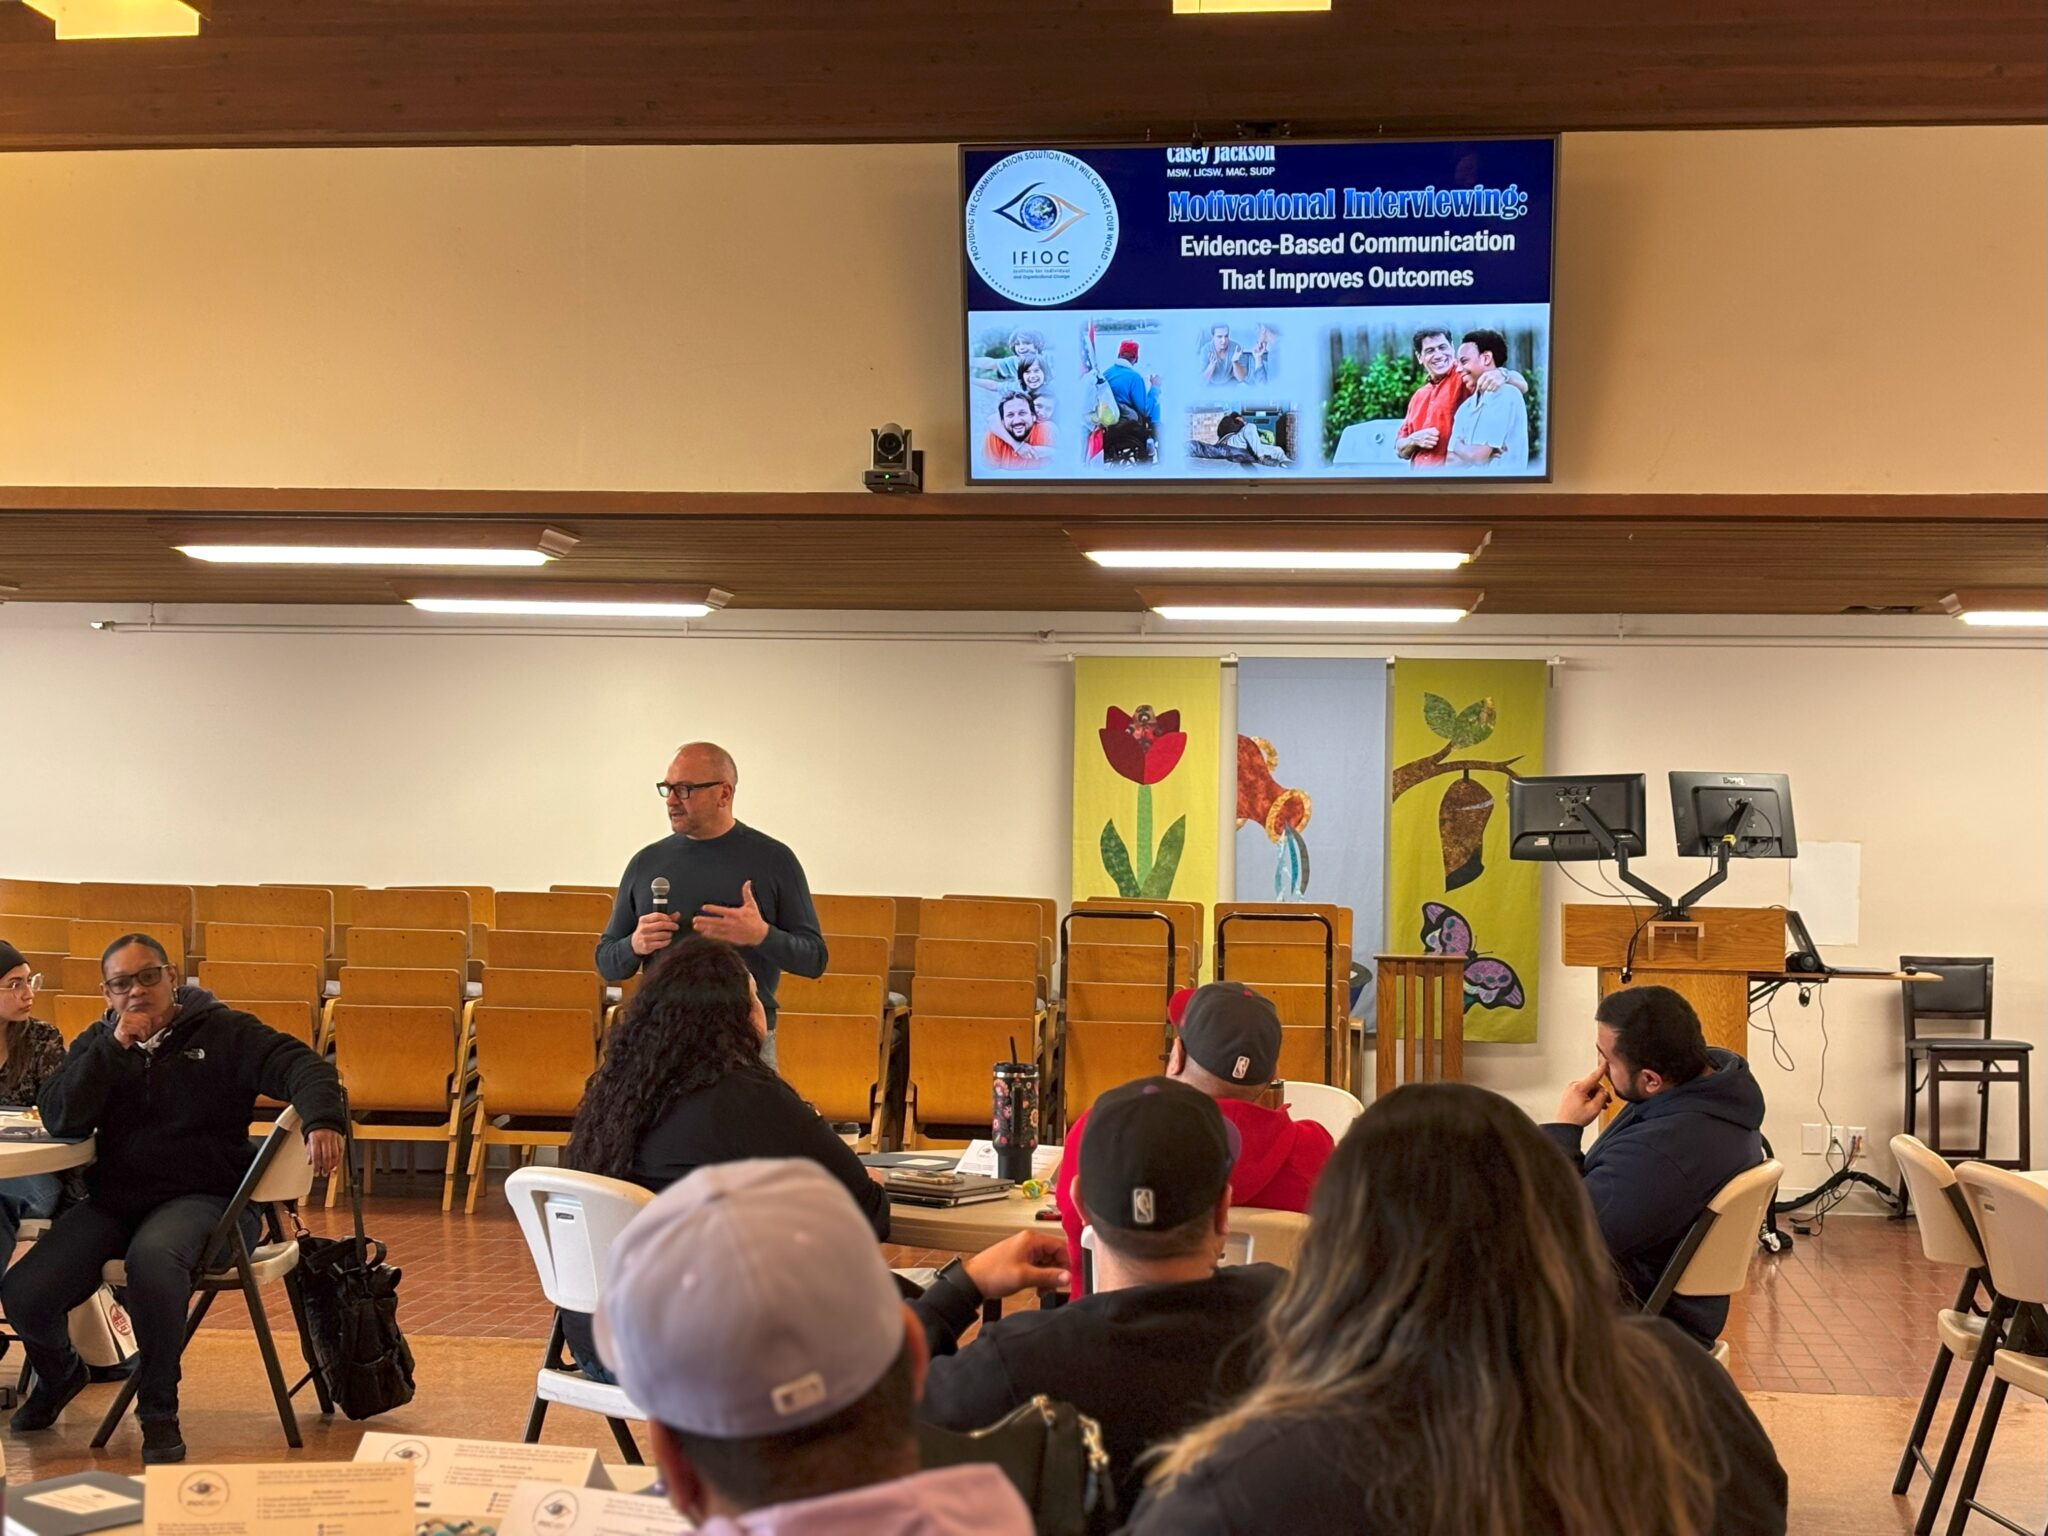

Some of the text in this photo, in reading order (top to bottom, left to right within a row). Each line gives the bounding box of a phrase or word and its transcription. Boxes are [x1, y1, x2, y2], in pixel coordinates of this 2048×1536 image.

[1167, 145, 1276, 164] Casey Jackson
[1167, 166, 1276, 178] MSW, LICSW, MAC, SUDP
[967, 151, 1115, 261] PROVIDING THE COMMUNICATION SOLUTION THAT WILL CHANGE YOUR WORLD
[1167, 183, 1528, 223] Motivational Interviewing:
[1180, 229, 1516, 257] Evidence-Based Communication
[1012, 250, 1070, 265] IFIOC
[1218, 265, 1475, 294] That Improves Outcomes
[1555, 785, 1599, 797] acer
